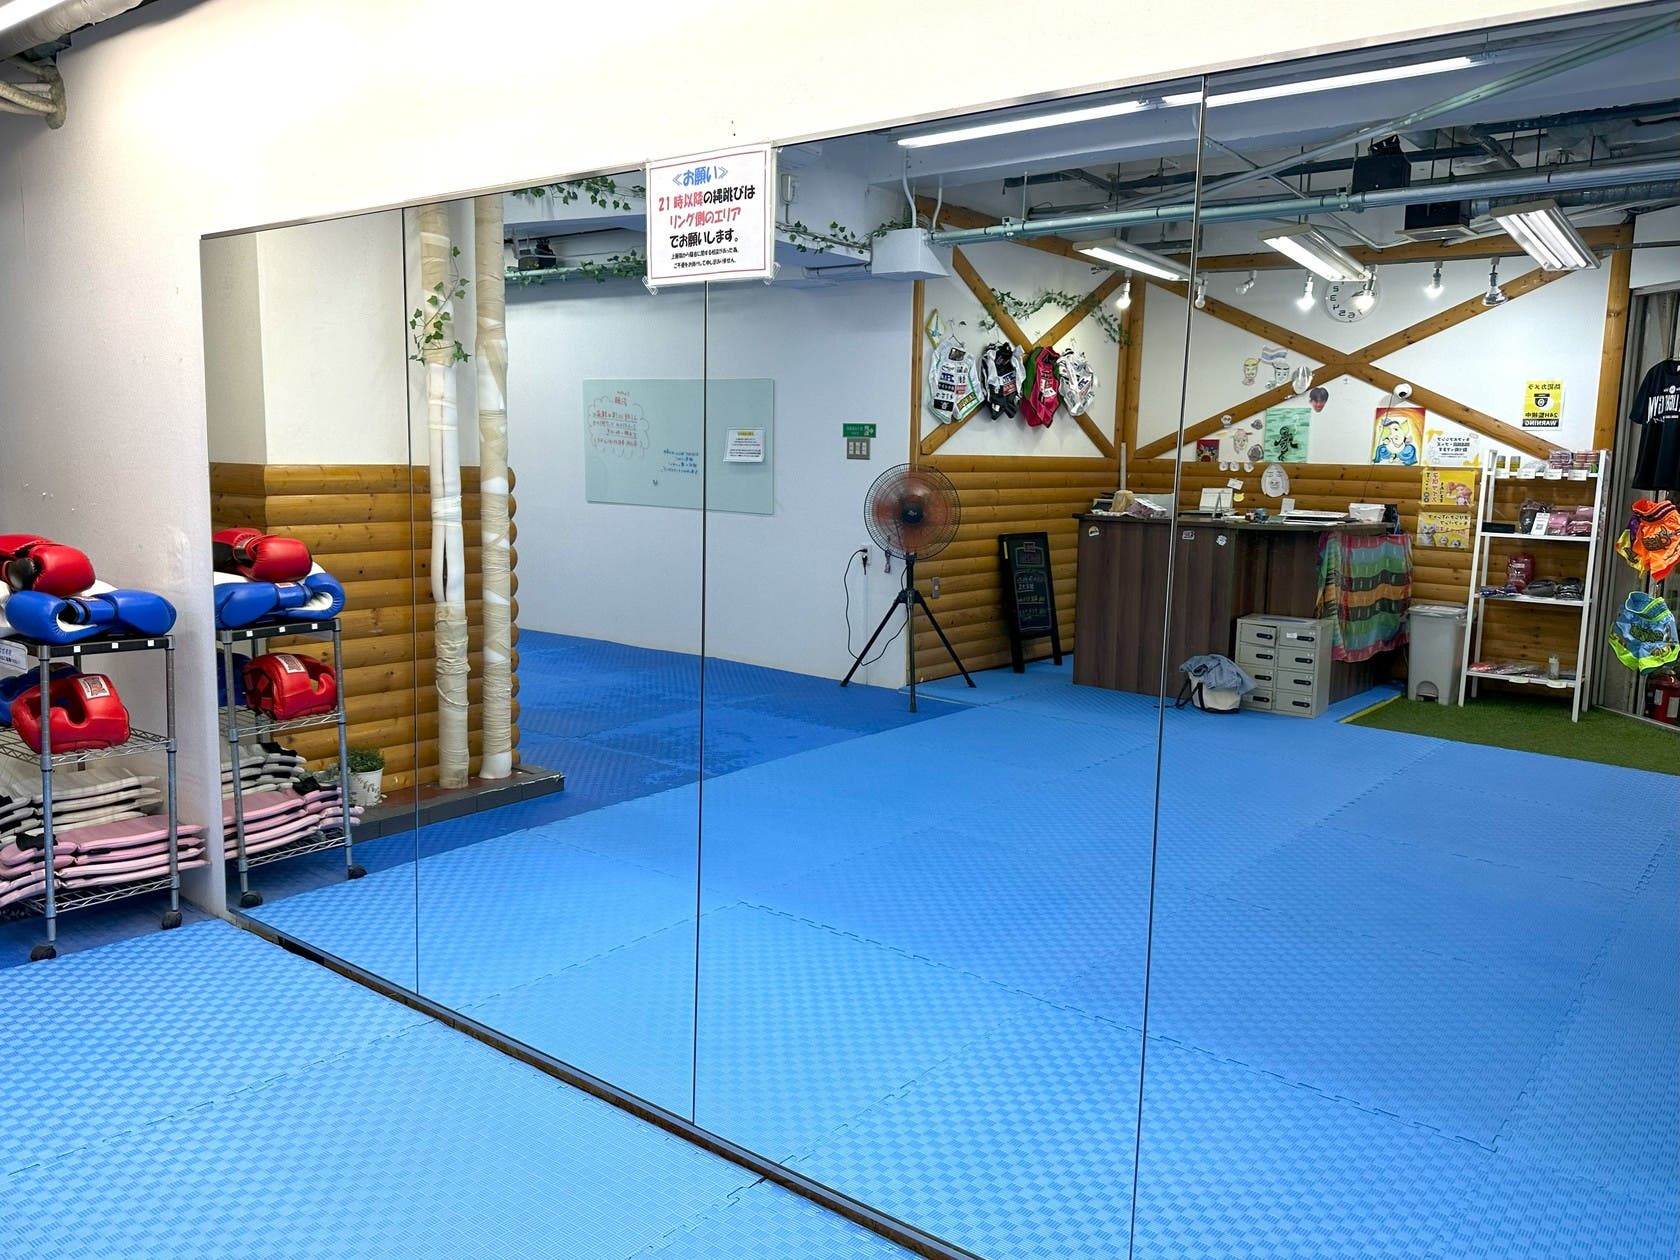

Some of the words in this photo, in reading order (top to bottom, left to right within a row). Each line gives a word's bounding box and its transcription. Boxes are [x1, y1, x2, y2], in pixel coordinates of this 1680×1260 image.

[670, 207, 741, 229] リング側のエリア
[669, 228, 738, 248] でお願いします。
